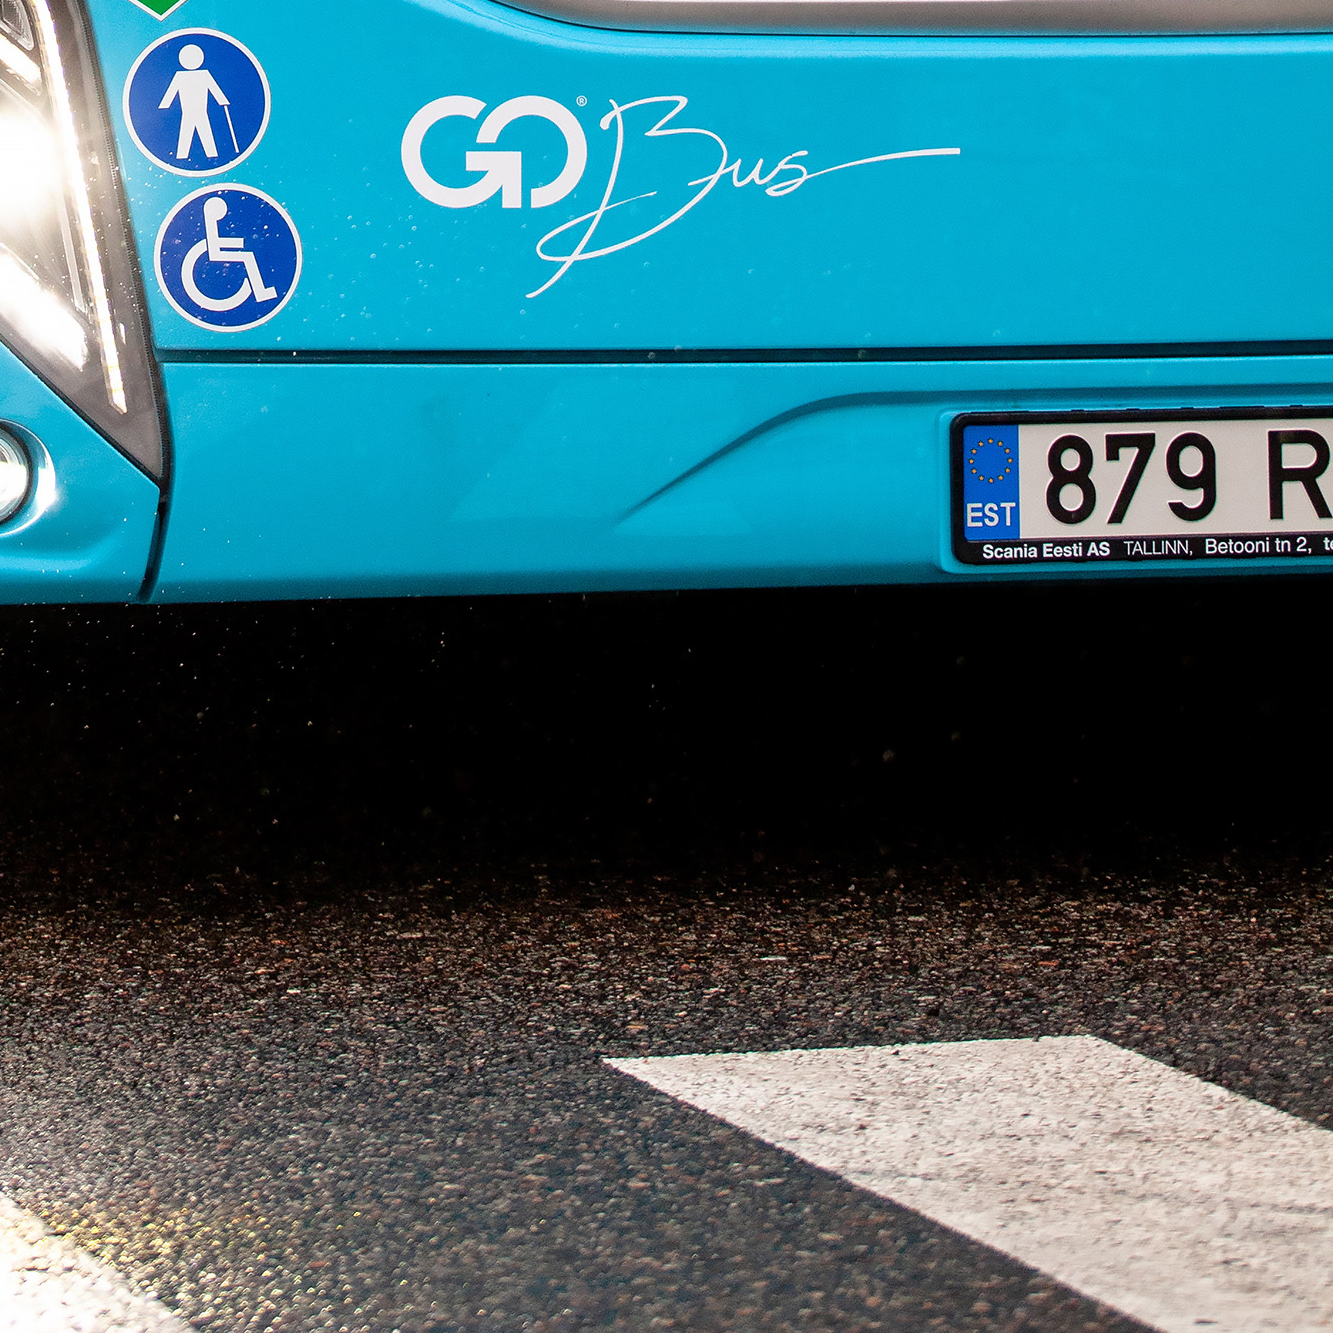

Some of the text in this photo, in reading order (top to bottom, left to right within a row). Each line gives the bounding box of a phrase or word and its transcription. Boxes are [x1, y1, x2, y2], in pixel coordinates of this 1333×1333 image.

[401, 94, 961, 299] GO Bus
[1046, 429, 1333, 525] 879 R
[966, 502, 1016, 527] EST
[982, 543, 1038, 560] Scania
[1042, 542, 1083, 558] Eesti
[1087, 541, 1111, 557] AS
[1123, 540, 1193, 557] TALLINN,
[1205, 536, 1270, 555] Betooni
[1274, 537, 1291, 553] tn
[1296, 536, 1312, 555] 2,
